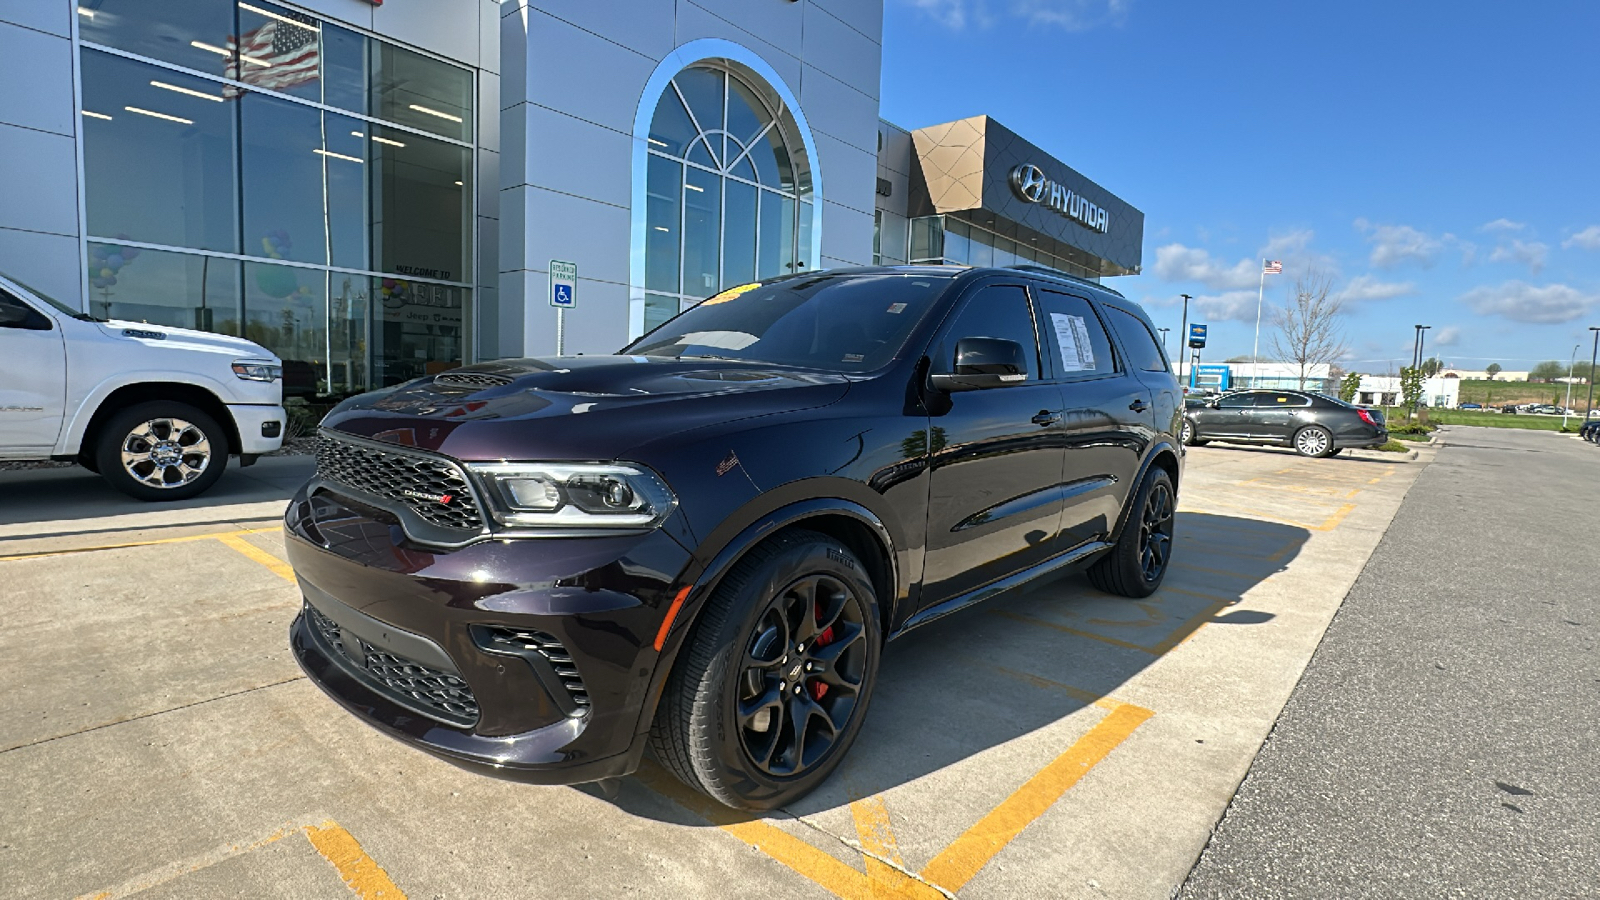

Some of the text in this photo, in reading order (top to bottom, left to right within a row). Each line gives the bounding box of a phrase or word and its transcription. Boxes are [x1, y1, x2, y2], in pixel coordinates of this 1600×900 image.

[1050, 181, 1109, 233] HYUNDAI
[396, 265, 451, 279] WELCOME TO
[552, 272, 574, 281] PARKING
[407, 312, 429, 321] Jeep
[826, 547, 855, 570] PIRELLI
